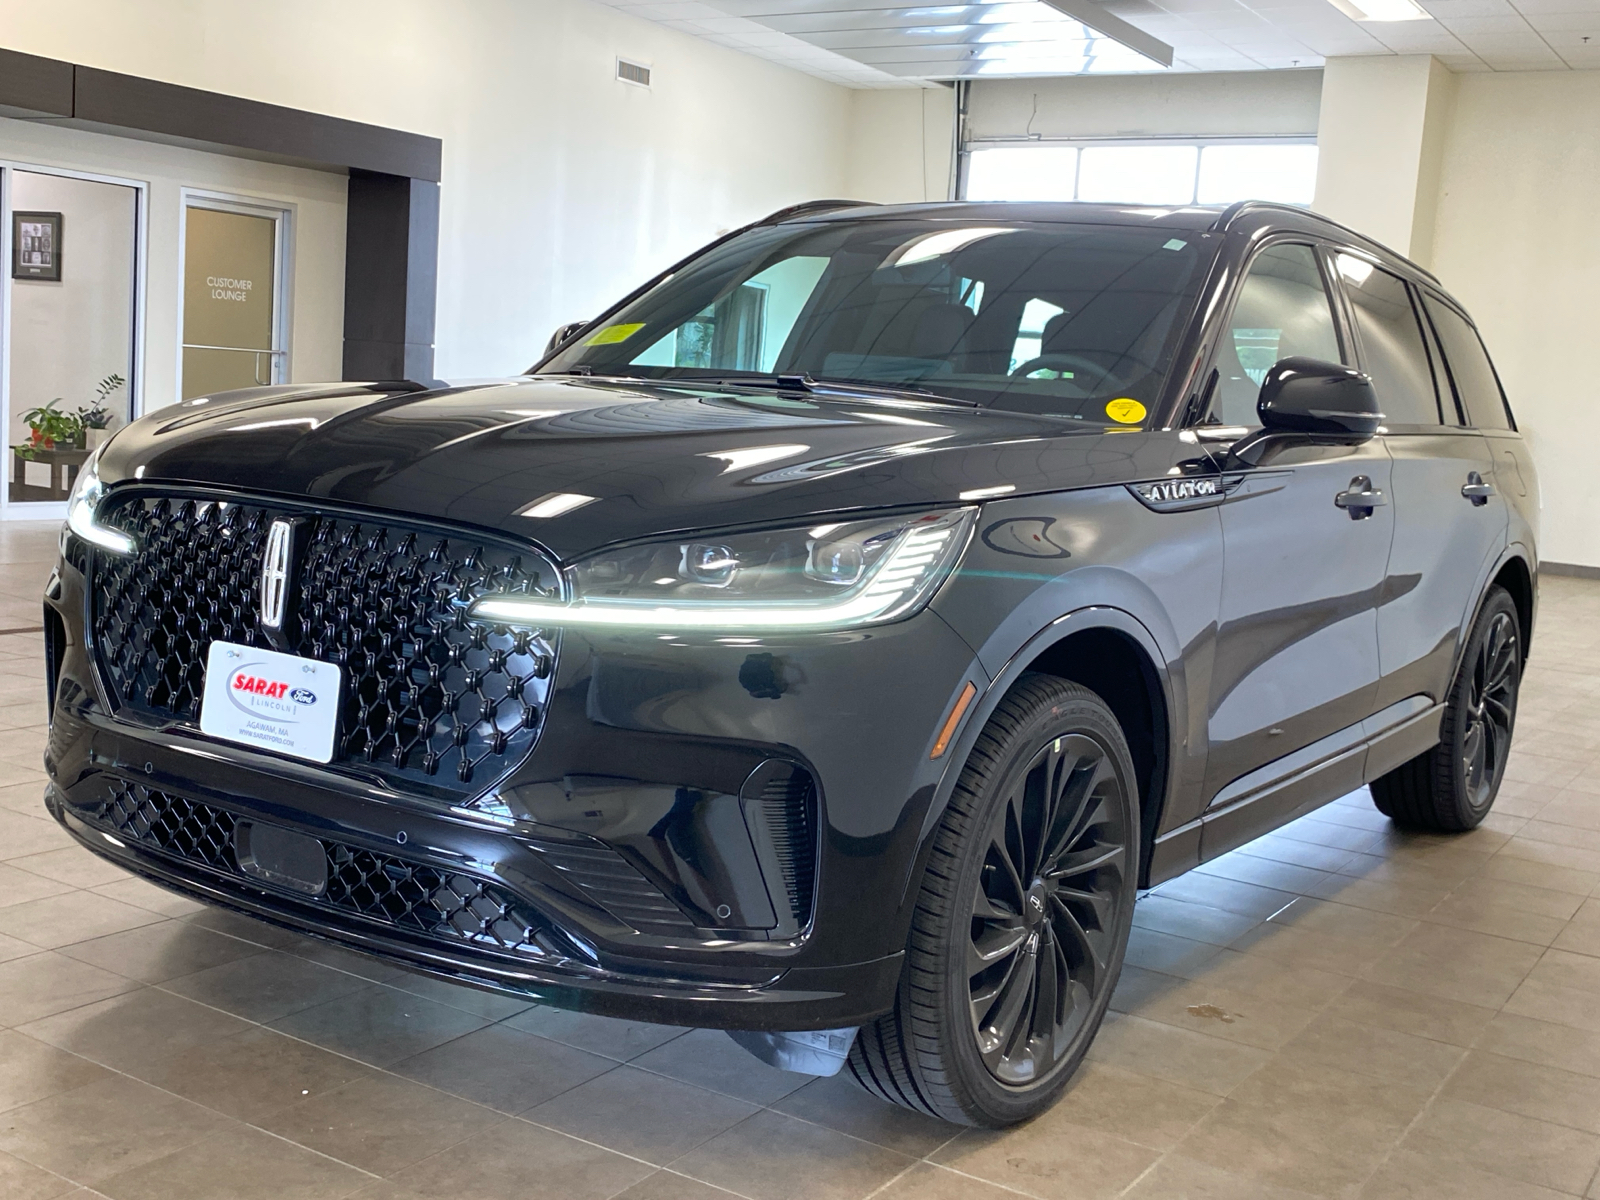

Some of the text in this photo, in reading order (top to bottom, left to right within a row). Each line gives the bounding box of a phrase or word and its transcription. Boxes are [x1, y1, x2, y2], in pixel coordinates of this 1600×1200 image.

[206, 276, 252, 290] CUSTOMER
[211, 289, 246, 302] LOUNGE
[1151, 481, 1216, 500] AVIATOR
[233, 673, 290, 699] SARAT
[293, 689, 314, 704] Ford
[256, 699, 291, 712] LINCOLN
[246, 720, 289, 737] AGAWAM, MA
[238, 728, 295, 747] WWW.SARATFORD.COM
